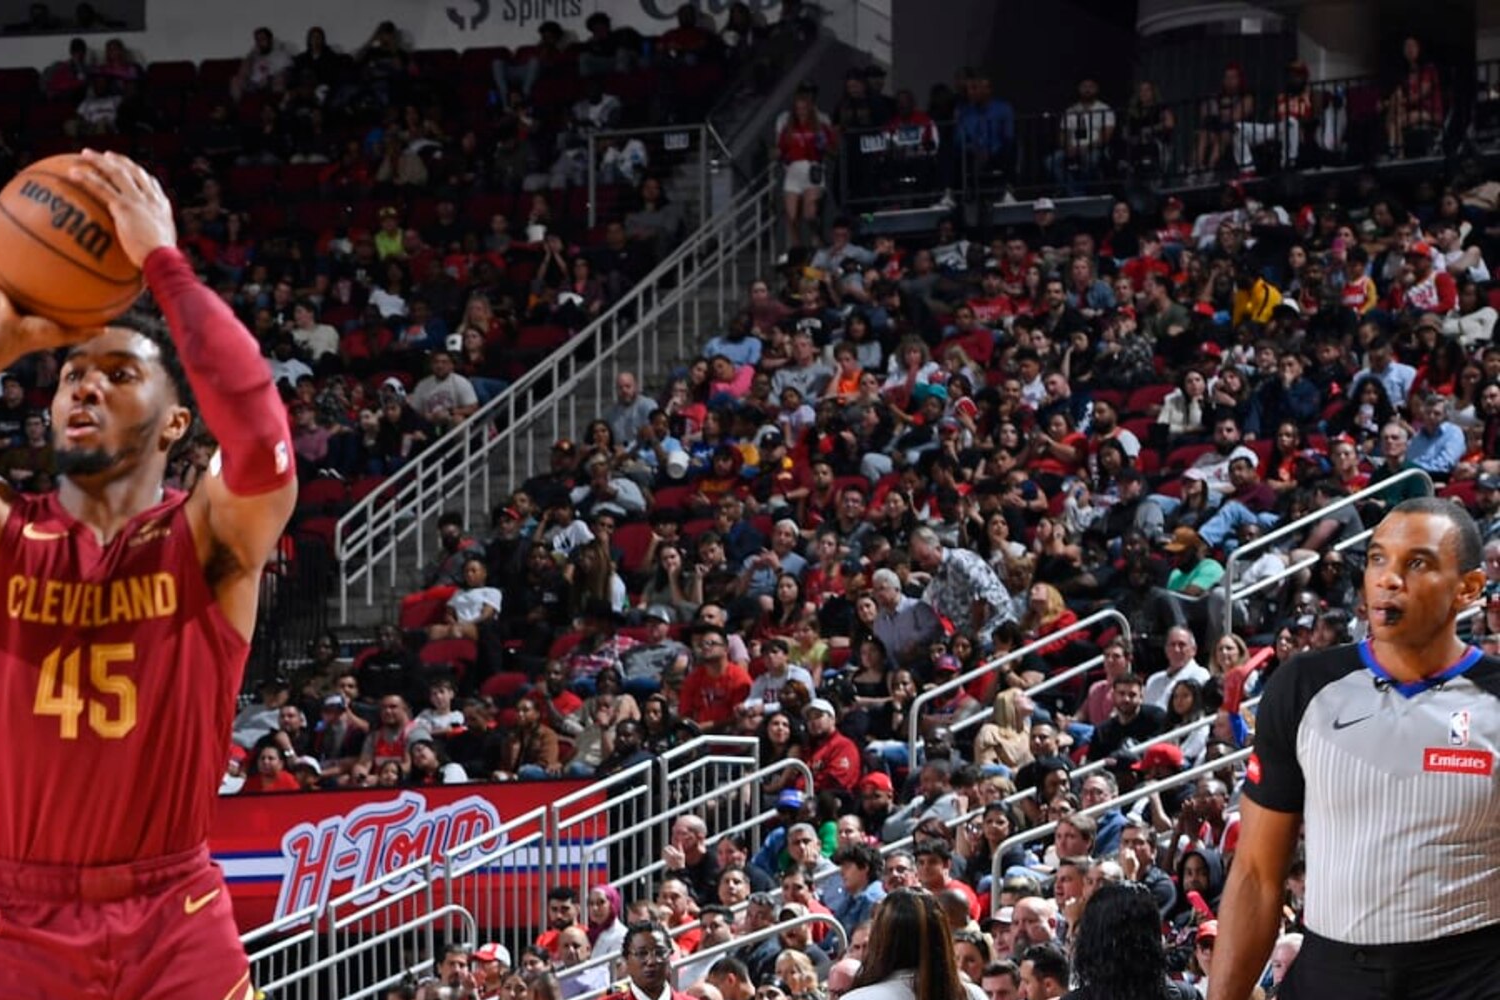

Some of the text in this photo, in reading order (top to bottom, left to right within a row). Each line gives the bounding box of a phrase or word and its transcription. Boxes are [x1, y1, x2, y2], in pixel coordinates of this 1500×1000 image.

[19, 180, 113, 262] Wilson
[7, 572, 178, 627] CLEVELAND
[32, 642, 138, 740] 45
[1428, 752, 1487, 769] Emirates
